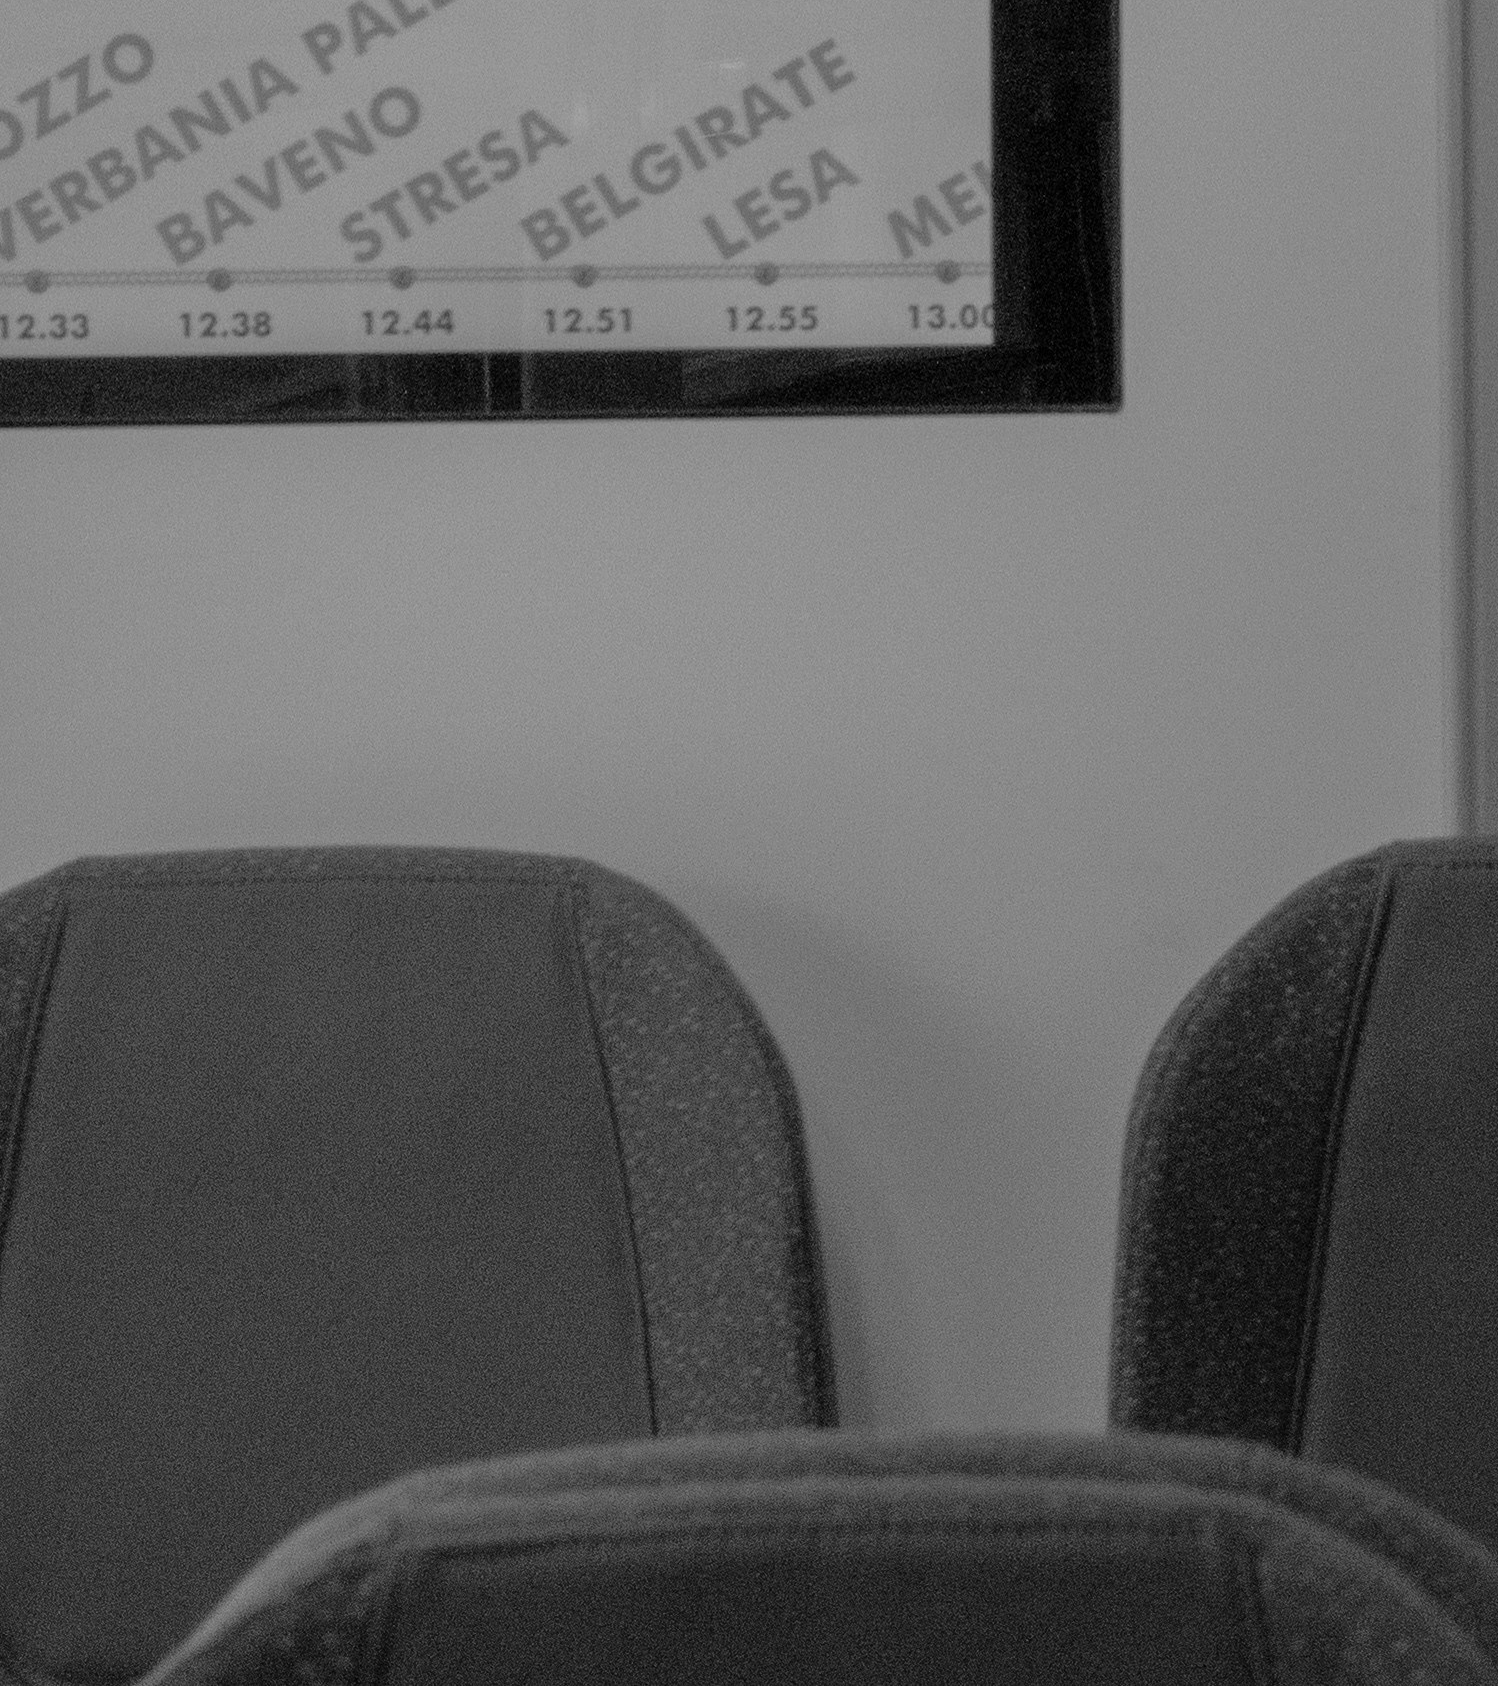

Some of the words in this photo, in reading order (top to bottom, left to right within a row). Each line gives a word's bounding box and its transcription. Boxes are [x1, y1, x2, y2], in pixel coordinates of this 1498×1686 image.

[155, 86, 422, 265] BAVENO
[340, 110, 570, 264] STRESA
[520, 38, 856, 262] BELGIRATE
[701, 146, 861, 261] LESA
[180, 311, 272, 338] 12.38
[361, 309, 456, 336] 12.44
[544, 307, 634, 334] 12.51
[725, 306, 819, 332] 12.55
